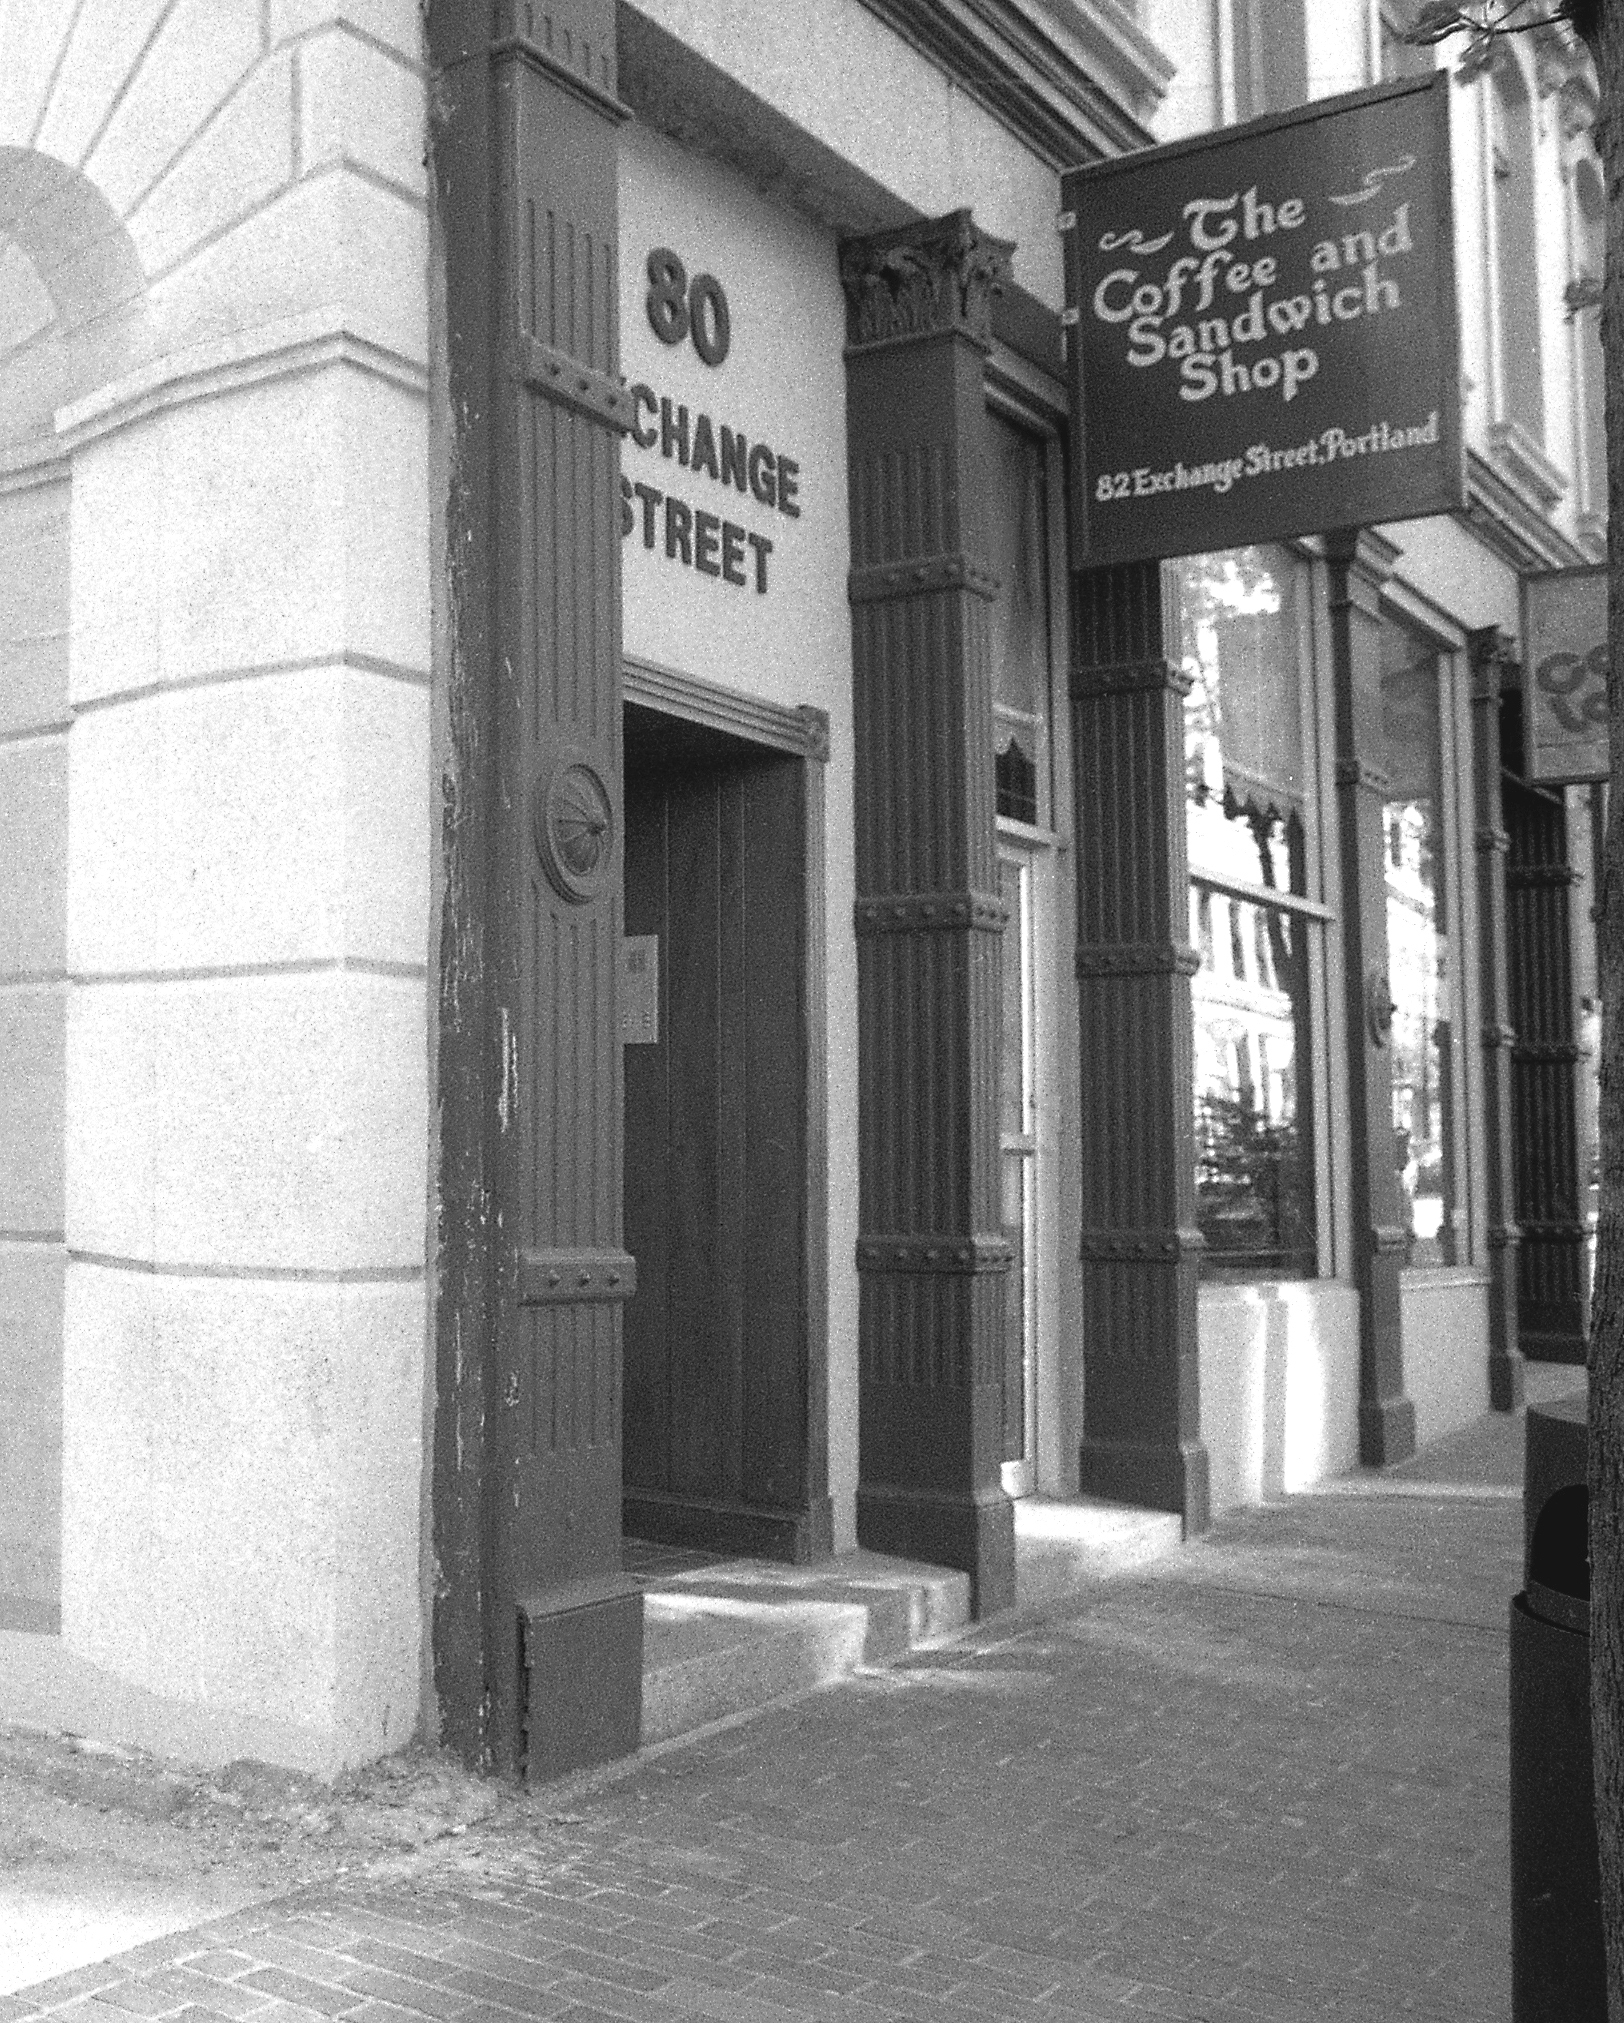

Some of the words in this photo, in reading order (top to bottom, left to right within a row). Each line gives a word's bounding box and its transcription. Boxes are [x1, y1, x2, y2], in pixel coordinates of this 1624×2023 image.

[1093, 249, 1277, 323] Coffee
[1310, 202, 1412, 273] and
[1183, 185, 1306, 251] The
[646, 247, 730, 367] 80
[1127, 262, 1400, 367] Sandwich
[1179, 347, 1319, 401] Shop
[631, 383, 800, 518] CHANGE
